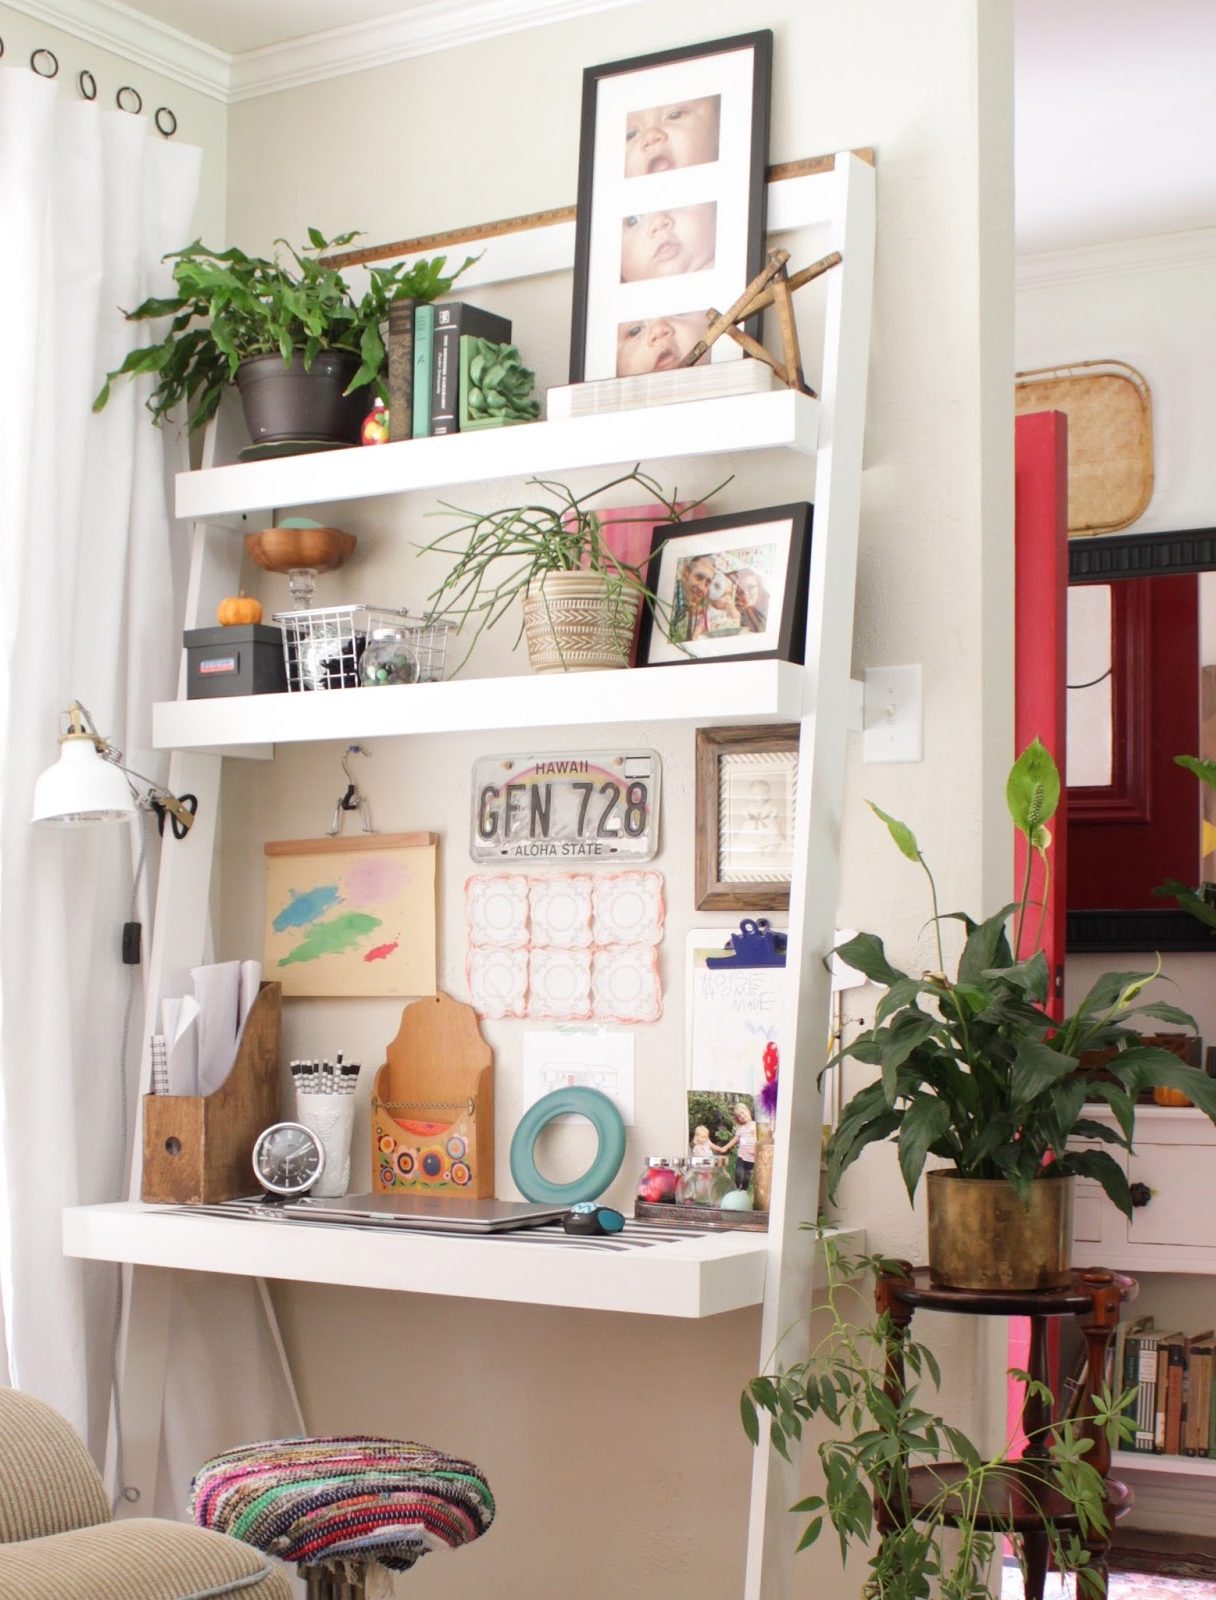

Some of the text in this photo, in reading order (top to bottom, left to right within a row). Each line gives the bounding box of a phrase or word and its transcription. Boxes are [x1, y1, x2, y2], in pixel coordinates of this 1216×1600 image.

[536, 760, 588, 775] HAWAII
[480, 781, 648, 840] GFN 728
[515, 842, 602, 857] ALOHA STATE
